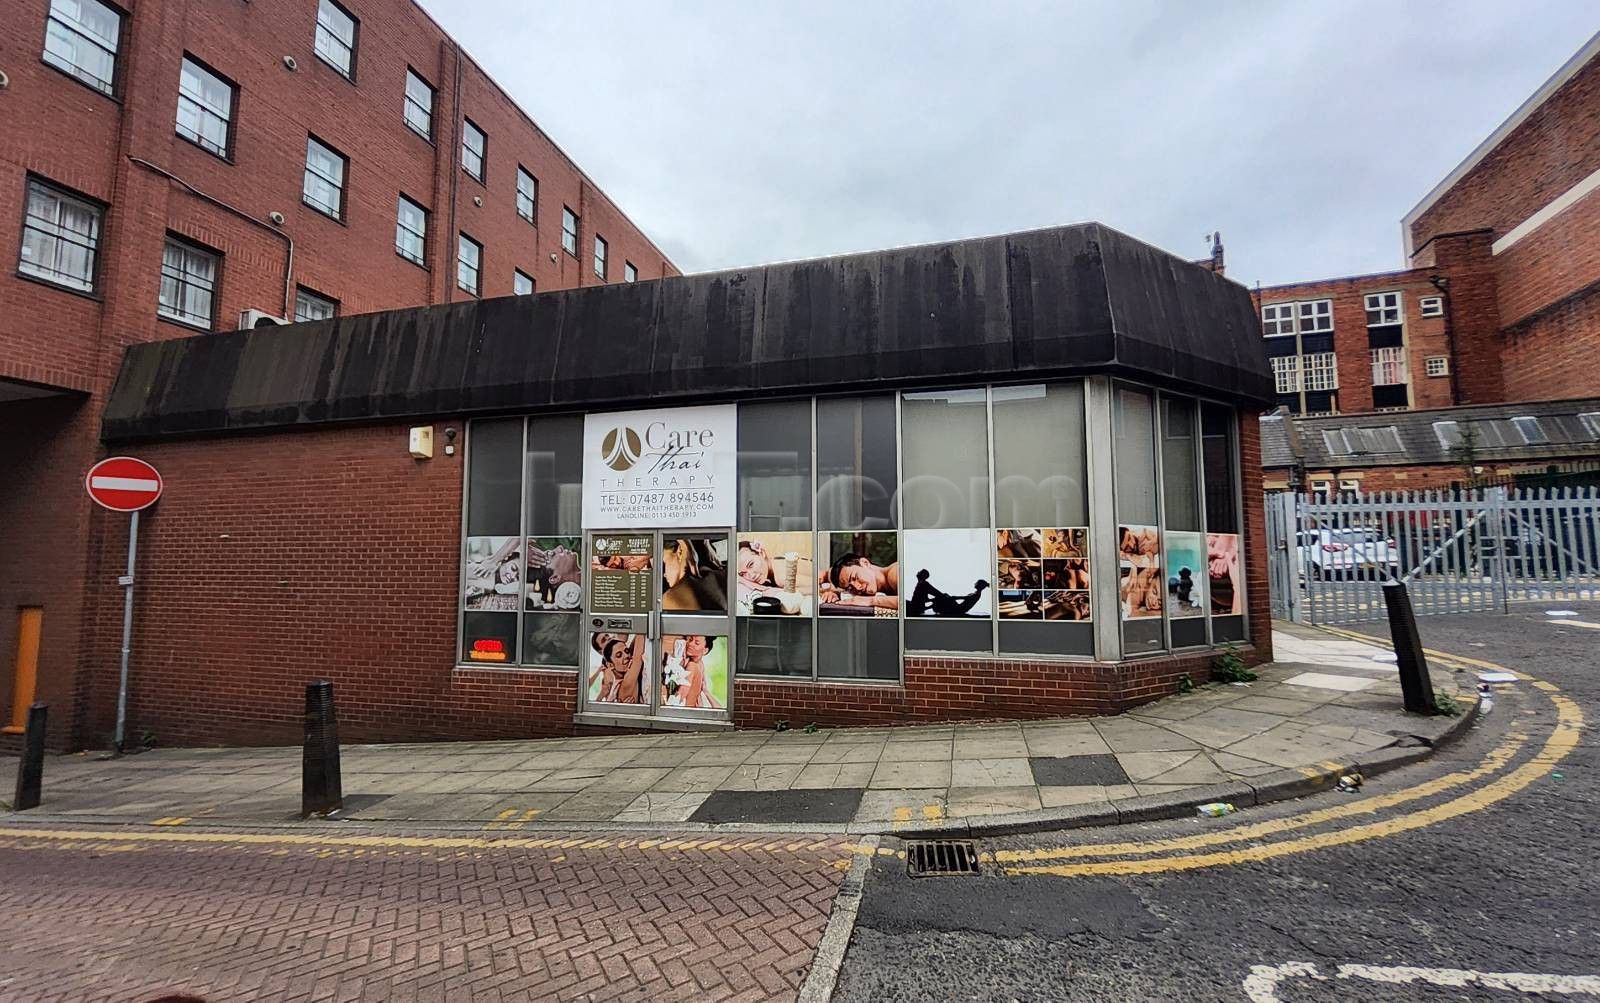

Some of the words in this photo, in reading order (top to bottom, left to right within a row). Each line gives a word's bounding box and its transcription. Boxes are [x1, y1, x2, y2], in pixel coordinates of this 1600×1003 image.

[645, 421, 714, 449] Care
[645, 445, 704, 474] Thai
[600, 475, 714, 488] THERAPY
[600, 495, 625, 506] TEL:
[629, 493, 664, 505] 07487
[669, 492, 714, 504] 894546
[600, 504, 714, 513] WWW.CARETHAITHERAPY.COM
